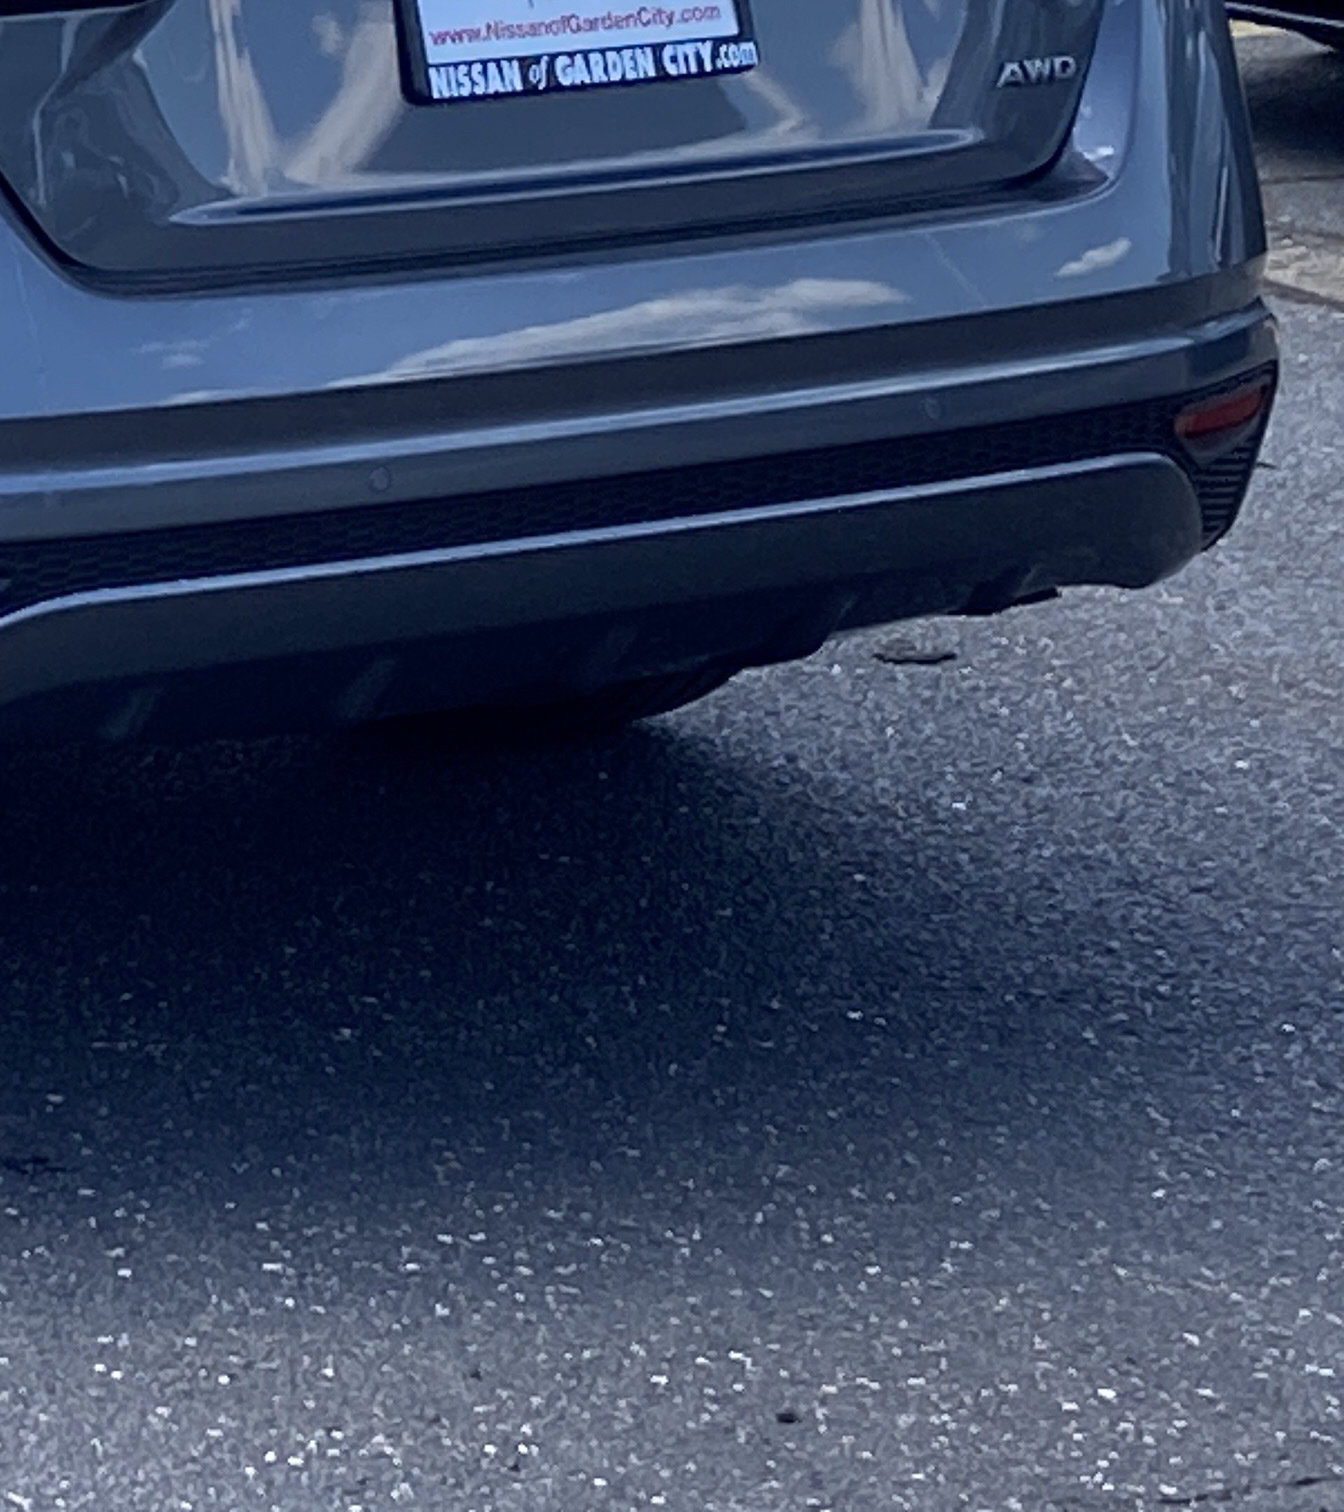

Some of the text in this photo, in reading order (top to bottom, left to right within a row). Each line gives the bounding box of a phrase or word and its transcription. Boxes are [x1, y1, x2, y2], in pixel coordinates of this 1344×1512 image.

[428, 5, 722, 46] www.NissanofGardenCity.com
[429, 58, 524, 100] NISSAN
[528, 55, 549, 90] of
[554, 45, 657, 87] GARDEN
[996, 55, 1077, 88] AWD
